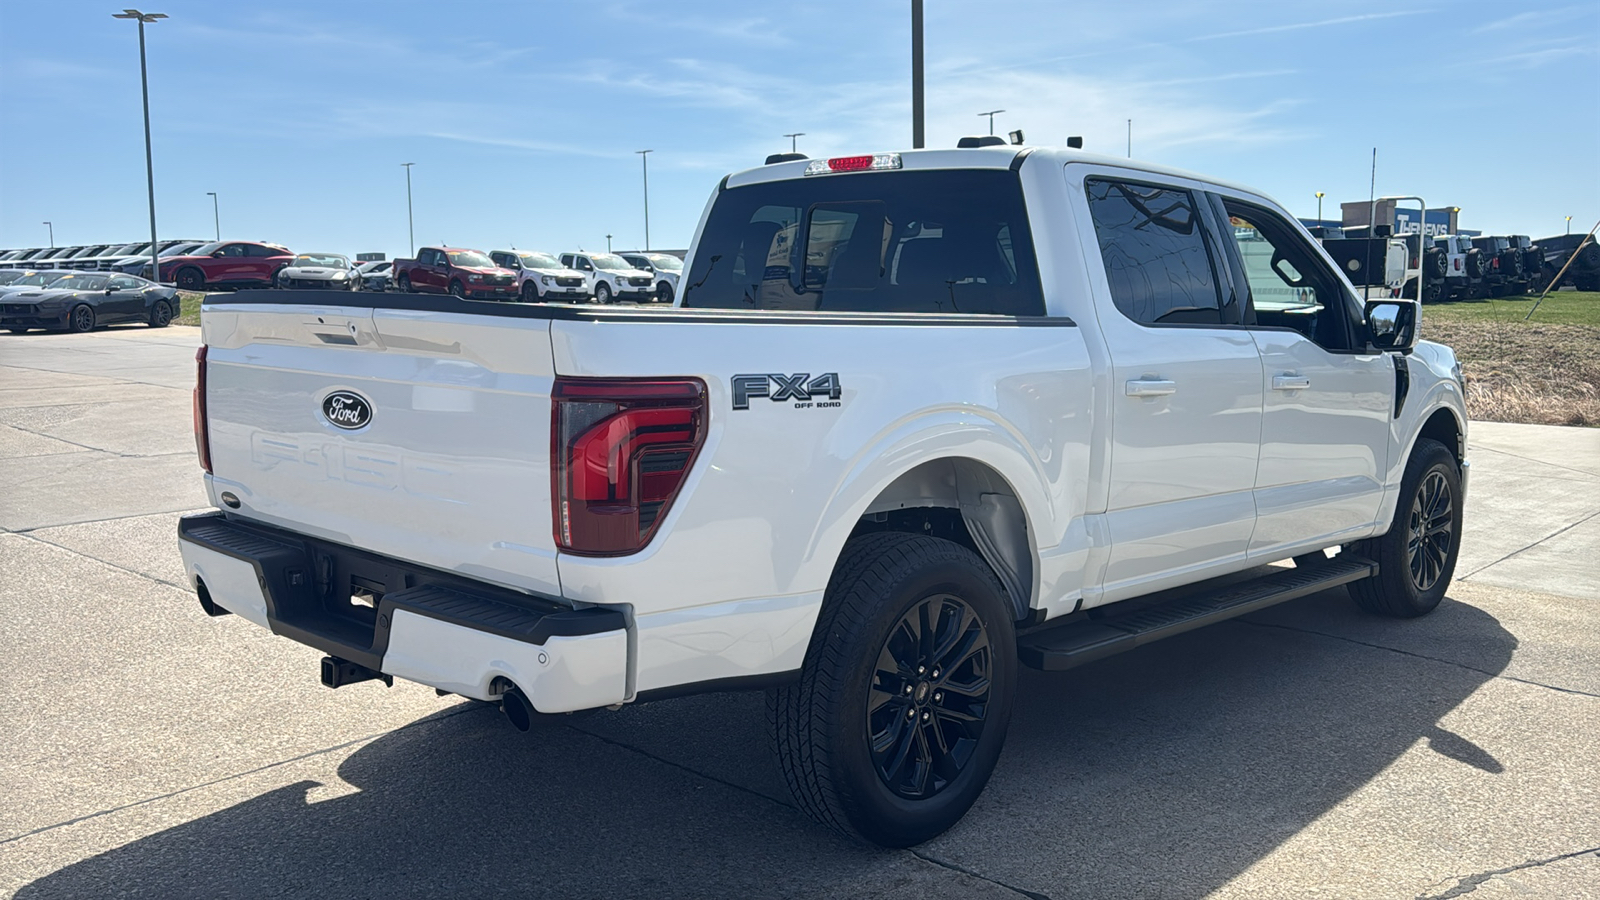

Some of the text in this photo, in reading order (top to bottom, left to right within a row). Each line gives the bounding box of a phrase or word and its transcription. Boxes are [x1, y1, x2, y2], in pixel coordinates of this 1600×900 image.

[1397, 214, 1448, 236] THEIEN'S
[731, 373, 842, 411] FX4
[328, 396, 361, 423] Ford
